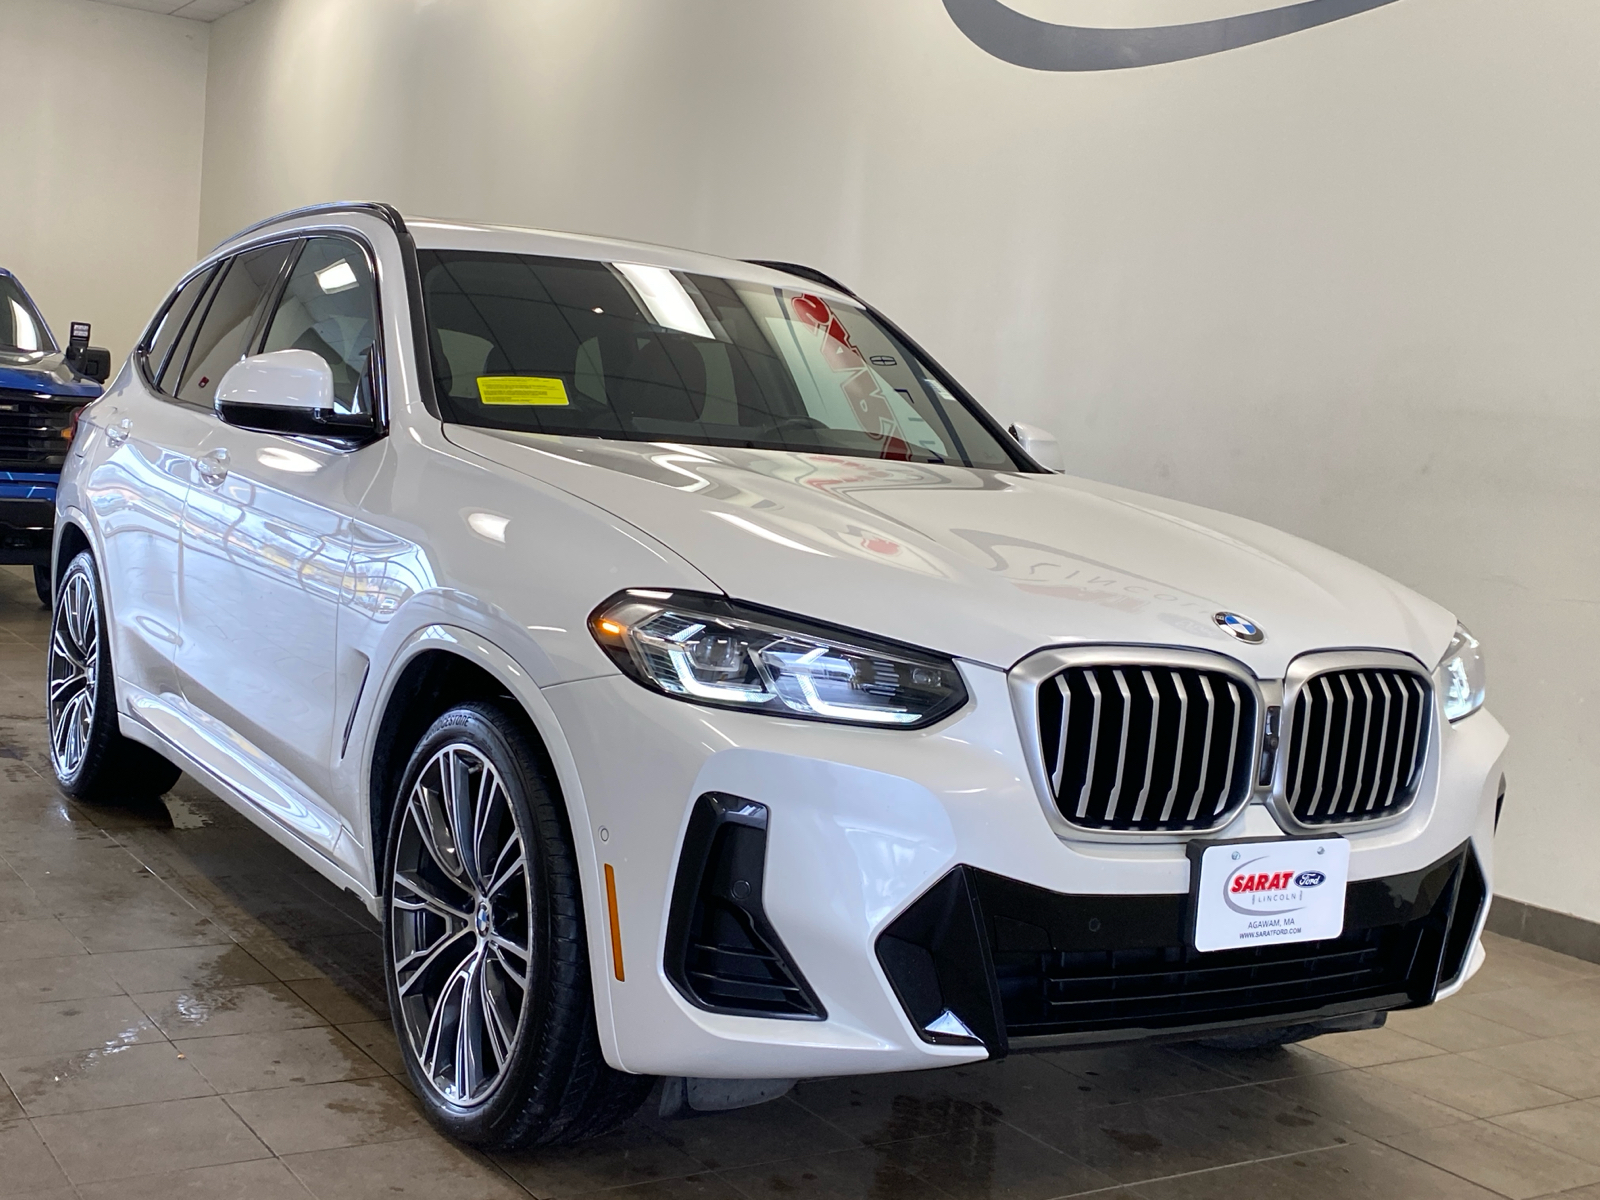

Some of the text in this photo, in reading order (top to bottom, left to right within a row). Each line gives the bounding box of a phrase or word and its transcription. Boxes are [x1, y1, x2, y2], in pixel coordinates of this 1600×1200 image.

[1230, 871, 1322, 894] SARAT Ford
[1258, 893, 1296, 903] LINCOLN
[1248, 918, 1295, 929] AGAWAM, MA
[1239, 927, 1302, 939] WWW.SARATFORD.COM
